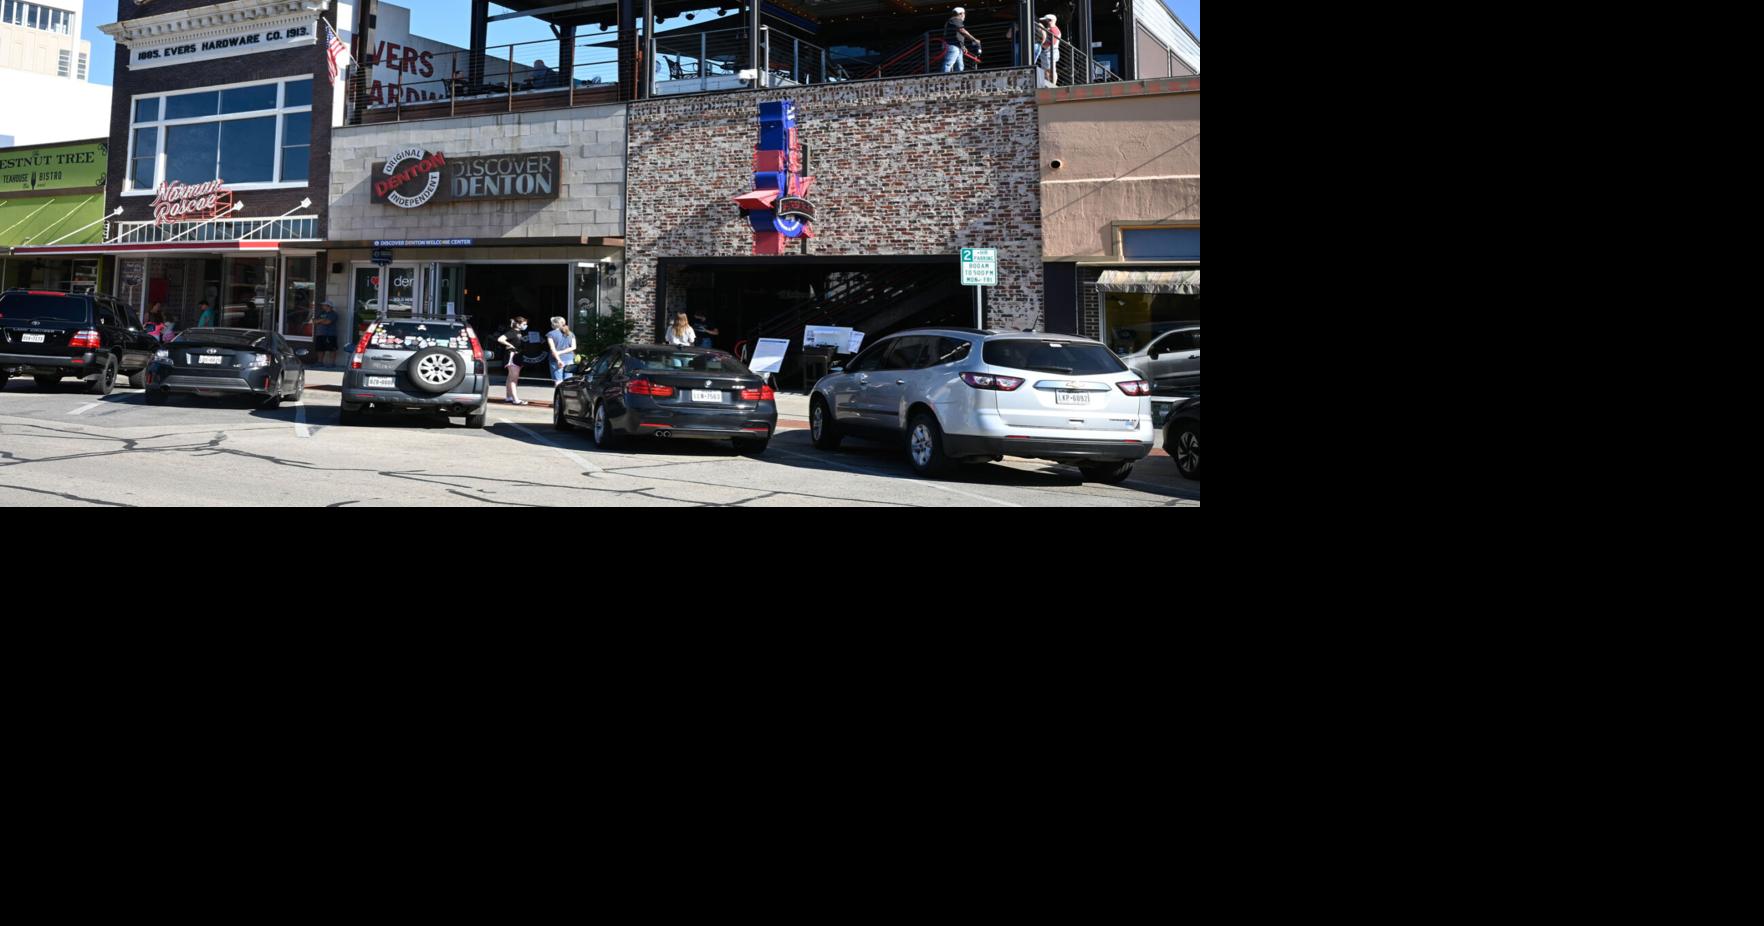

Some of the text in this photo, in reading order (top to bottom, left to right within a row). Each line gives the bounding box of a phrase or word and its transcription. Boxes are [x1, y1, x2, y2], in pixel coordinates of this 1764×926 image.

[164, 44, 196, 57] EVERS
[202, 34, 260, 51] HARDWARE
[266, 30, 283, 41] CO.
[286, 27, 309, 38] 1913.
[56, 152, 94, 164] TREE
[386, 149, 421, 172] ORIGINAL
[452, 156, 551, 177] DISCOVER
[39, 171, 62, 181] BISTRO
[375, 151, 446, 196] DENTON
[149, 180, 223, 206] Norman
[391, 175, 437, 207] INDEPENDENT
[454, 174, 551, 197] DENTON
[154, 194, 217, 228] Roscoe
[963, 250, 971, 260] 2
